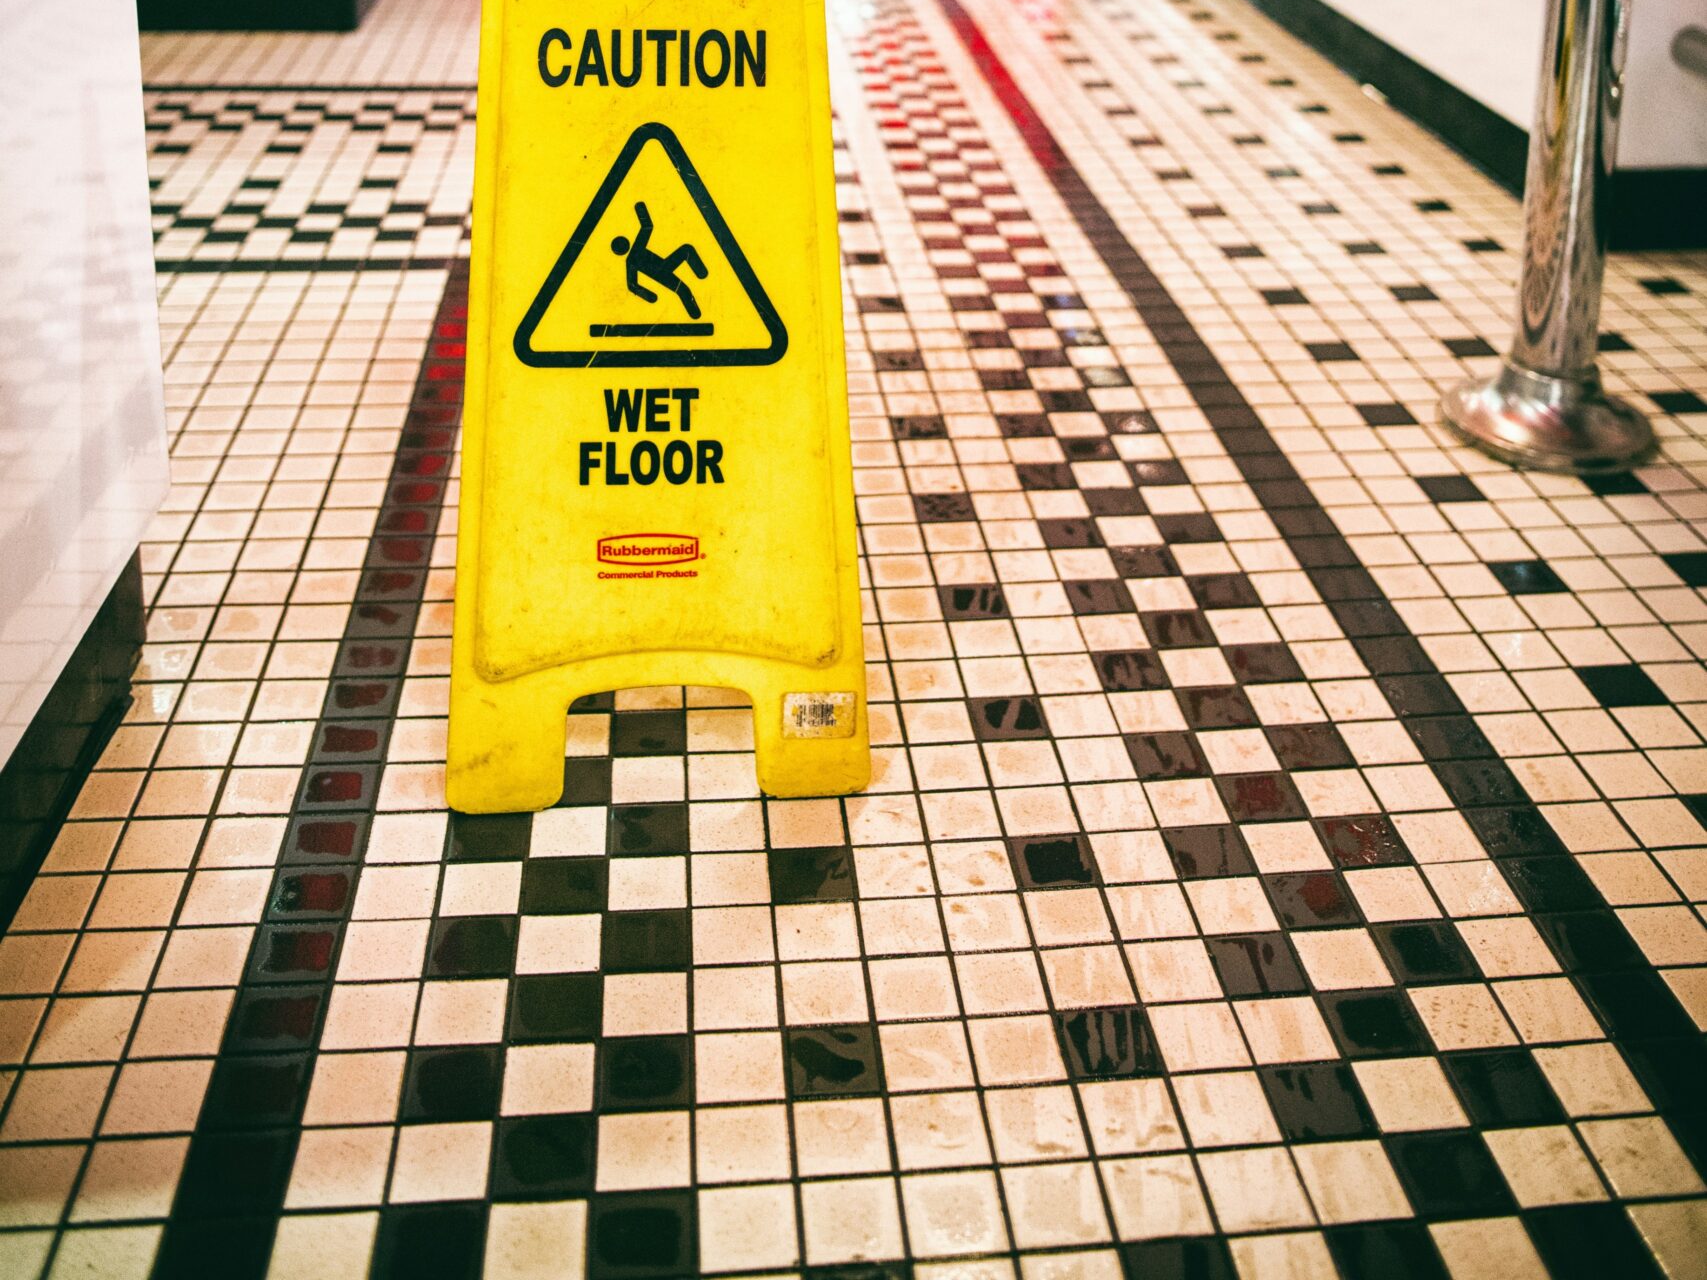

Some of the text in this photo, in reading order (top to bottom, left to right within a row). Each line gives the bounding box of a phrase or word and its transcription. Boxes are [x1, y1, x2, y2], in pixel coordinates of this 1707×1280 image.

[537, 27, 767, 89] CAUTION
[603, 387, 700, 433] WET
[578, 439, 725, 486] FLOOR
[602, 544, 694, 557] Rubbermaid
[597, 570, 698, 580] Commercial Products
